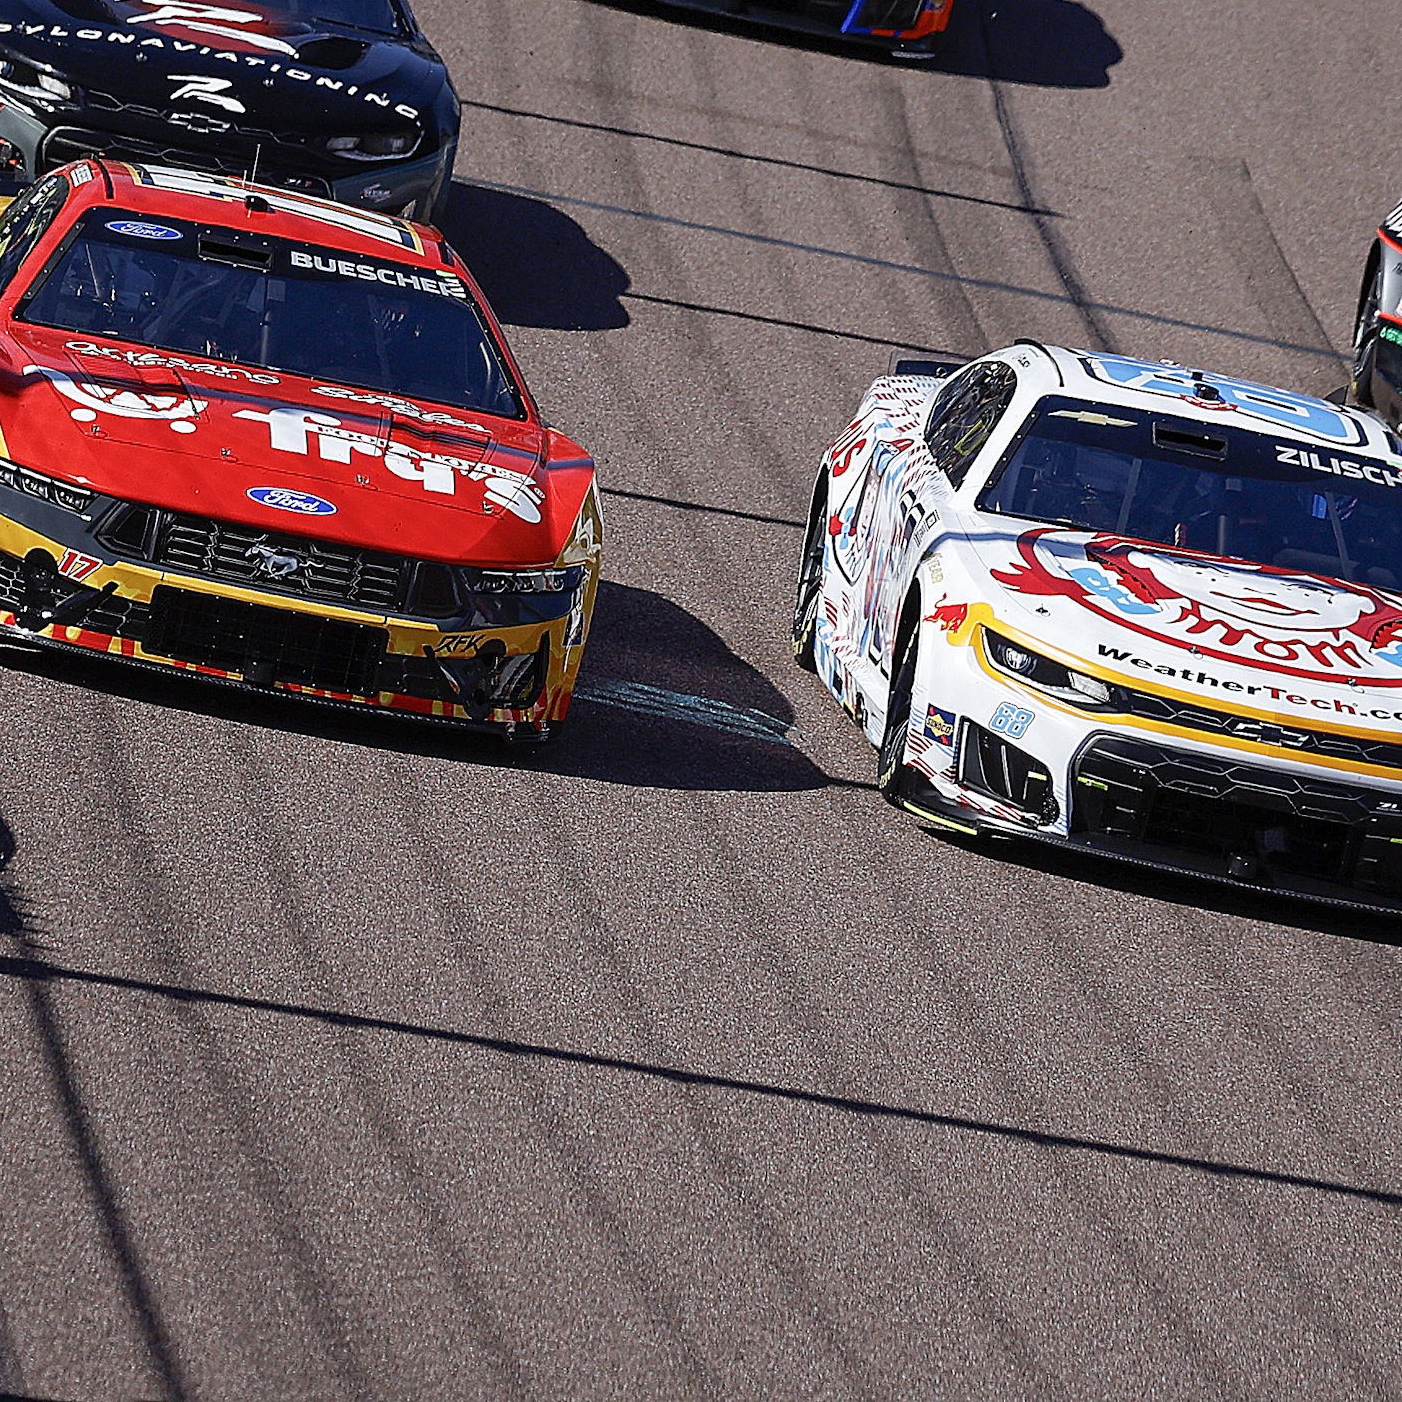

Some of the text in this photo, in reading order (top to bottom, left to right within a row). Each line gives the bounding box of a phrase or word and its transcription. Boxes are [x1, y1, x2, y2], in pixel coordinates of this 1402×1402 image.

[121, 222, 170, 240] Ford
[289, 250, 462, 298] BUESCHER
[263, 488, 321, 513] Ford
[57, 547, 105, 584] 17
[434, 633, 487, 654] RFK
[926, 717, 954, 735] SUNOCO
[988, 701, 1036, 740] 88
